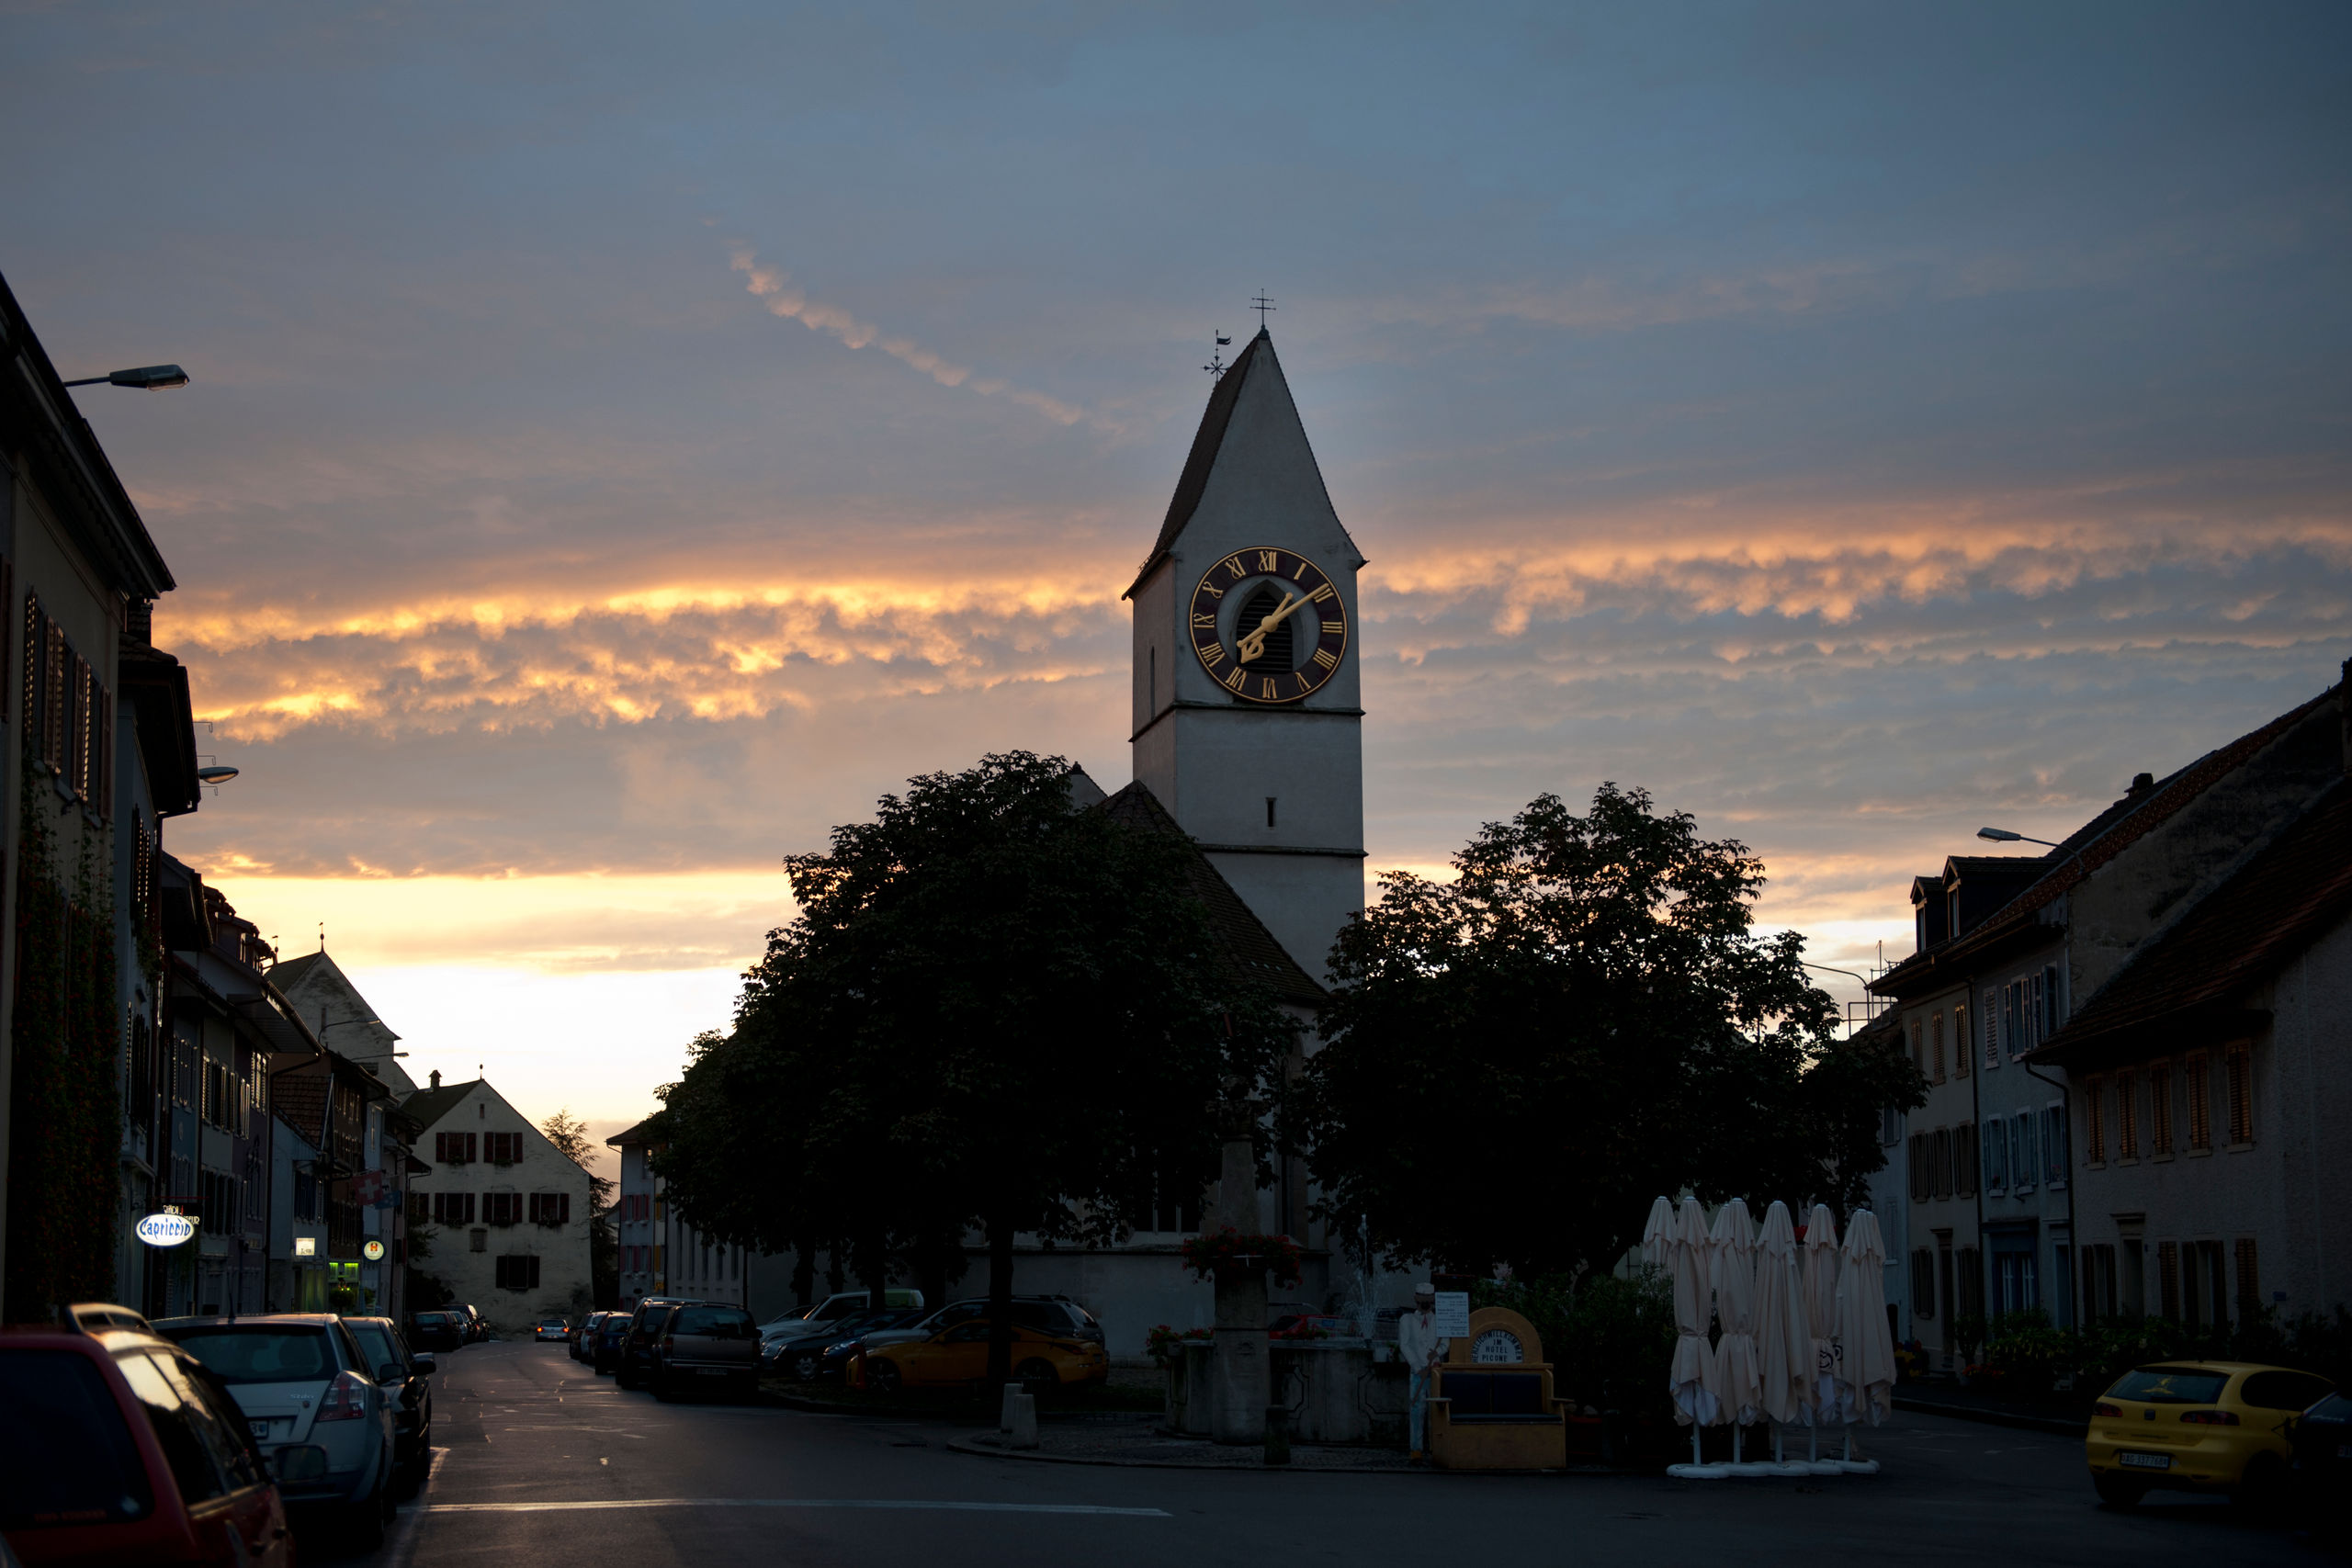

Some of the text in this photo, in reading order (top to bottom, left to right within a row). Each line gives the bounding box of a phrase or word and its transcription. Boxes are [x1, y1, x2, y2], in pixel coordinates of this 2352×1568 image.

[1225, 557, 1247, 580] XI
[1259, 550, 1276, 572] XII
[1294, 562, 1306, 580] I
[1202, 581, 1224, 599] X
[1193, 613, 1216, 629] IX
[1321, 621, 1343, 634] III
[1200, 641, 1226, 668] VIII
[1262, 677, 1278, 699] VI
[1295, 671, 1311, 692] V
[1482, 1354, 1508, 1362] PICONE
